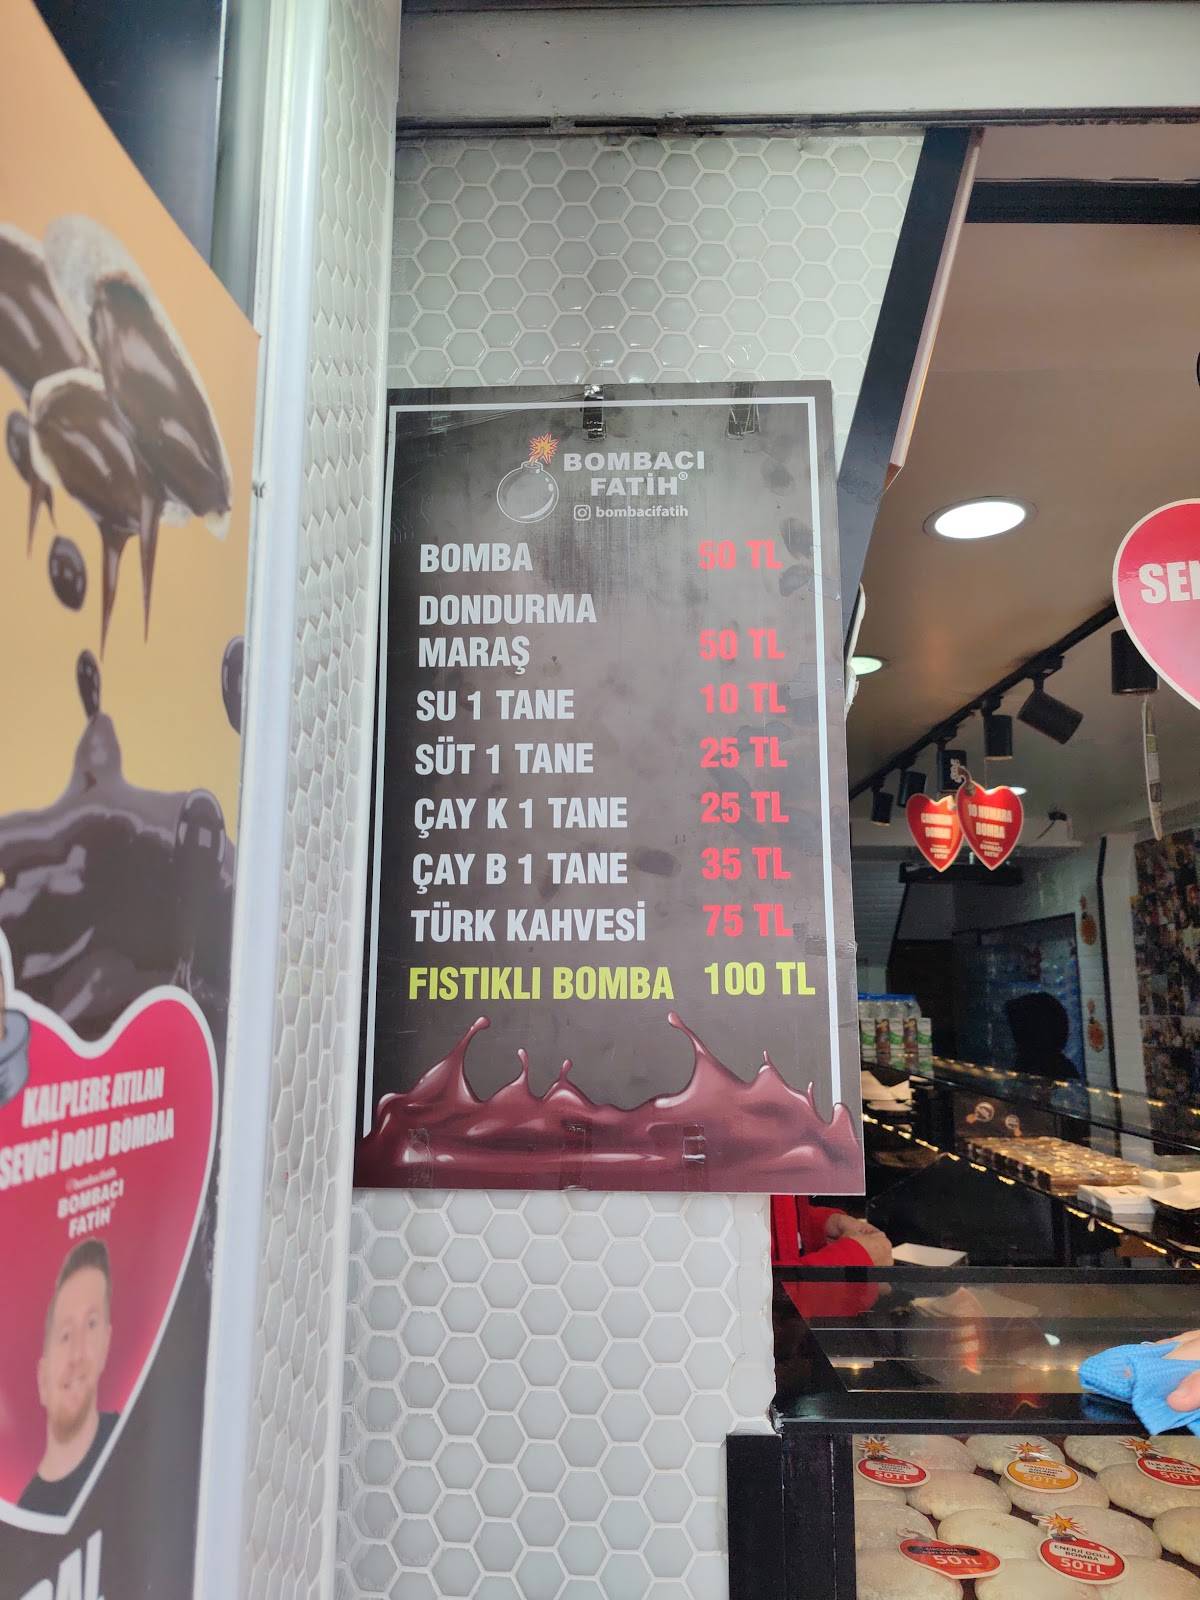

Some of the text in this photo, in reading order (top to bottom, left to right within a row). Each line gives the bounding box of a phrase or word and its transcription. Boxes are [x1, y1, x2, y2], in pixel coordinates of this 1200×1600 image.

[564, 451, 704, 471] BOMBACI
[596, 505, 688, 517] bombacifatih
[421, 540, 783, 572] BOMBA 50 TL
[420, 594, 597, 625] DONDURMA
[419, 628, 784, 674] MARAŞ 50 TL
[417, 682, 785, 721] SU 1 TANE 10 TL
[415, 736, 787, 775] SÜT 1 TANE 25 TL
[414, 791, 789, 838] ÇAY K 1 TANE 25 TL
[413, 848, 791, 894] ÇAY B 1 TANE 35 TL
[411, 901, 792, 942] TÜRK KAHVESİ 75 TL
[410, 961, 815, 1000] FISTIKLI BOMBA 100 TL
[22, 1066, 165, 1128] KALPLERE ATILAN
[0, 1129, 58, 1191] SEVGİ
[60, 1124, 108, 1171] DOLU
[57, 1178, 125, 1219] BOMBACI
